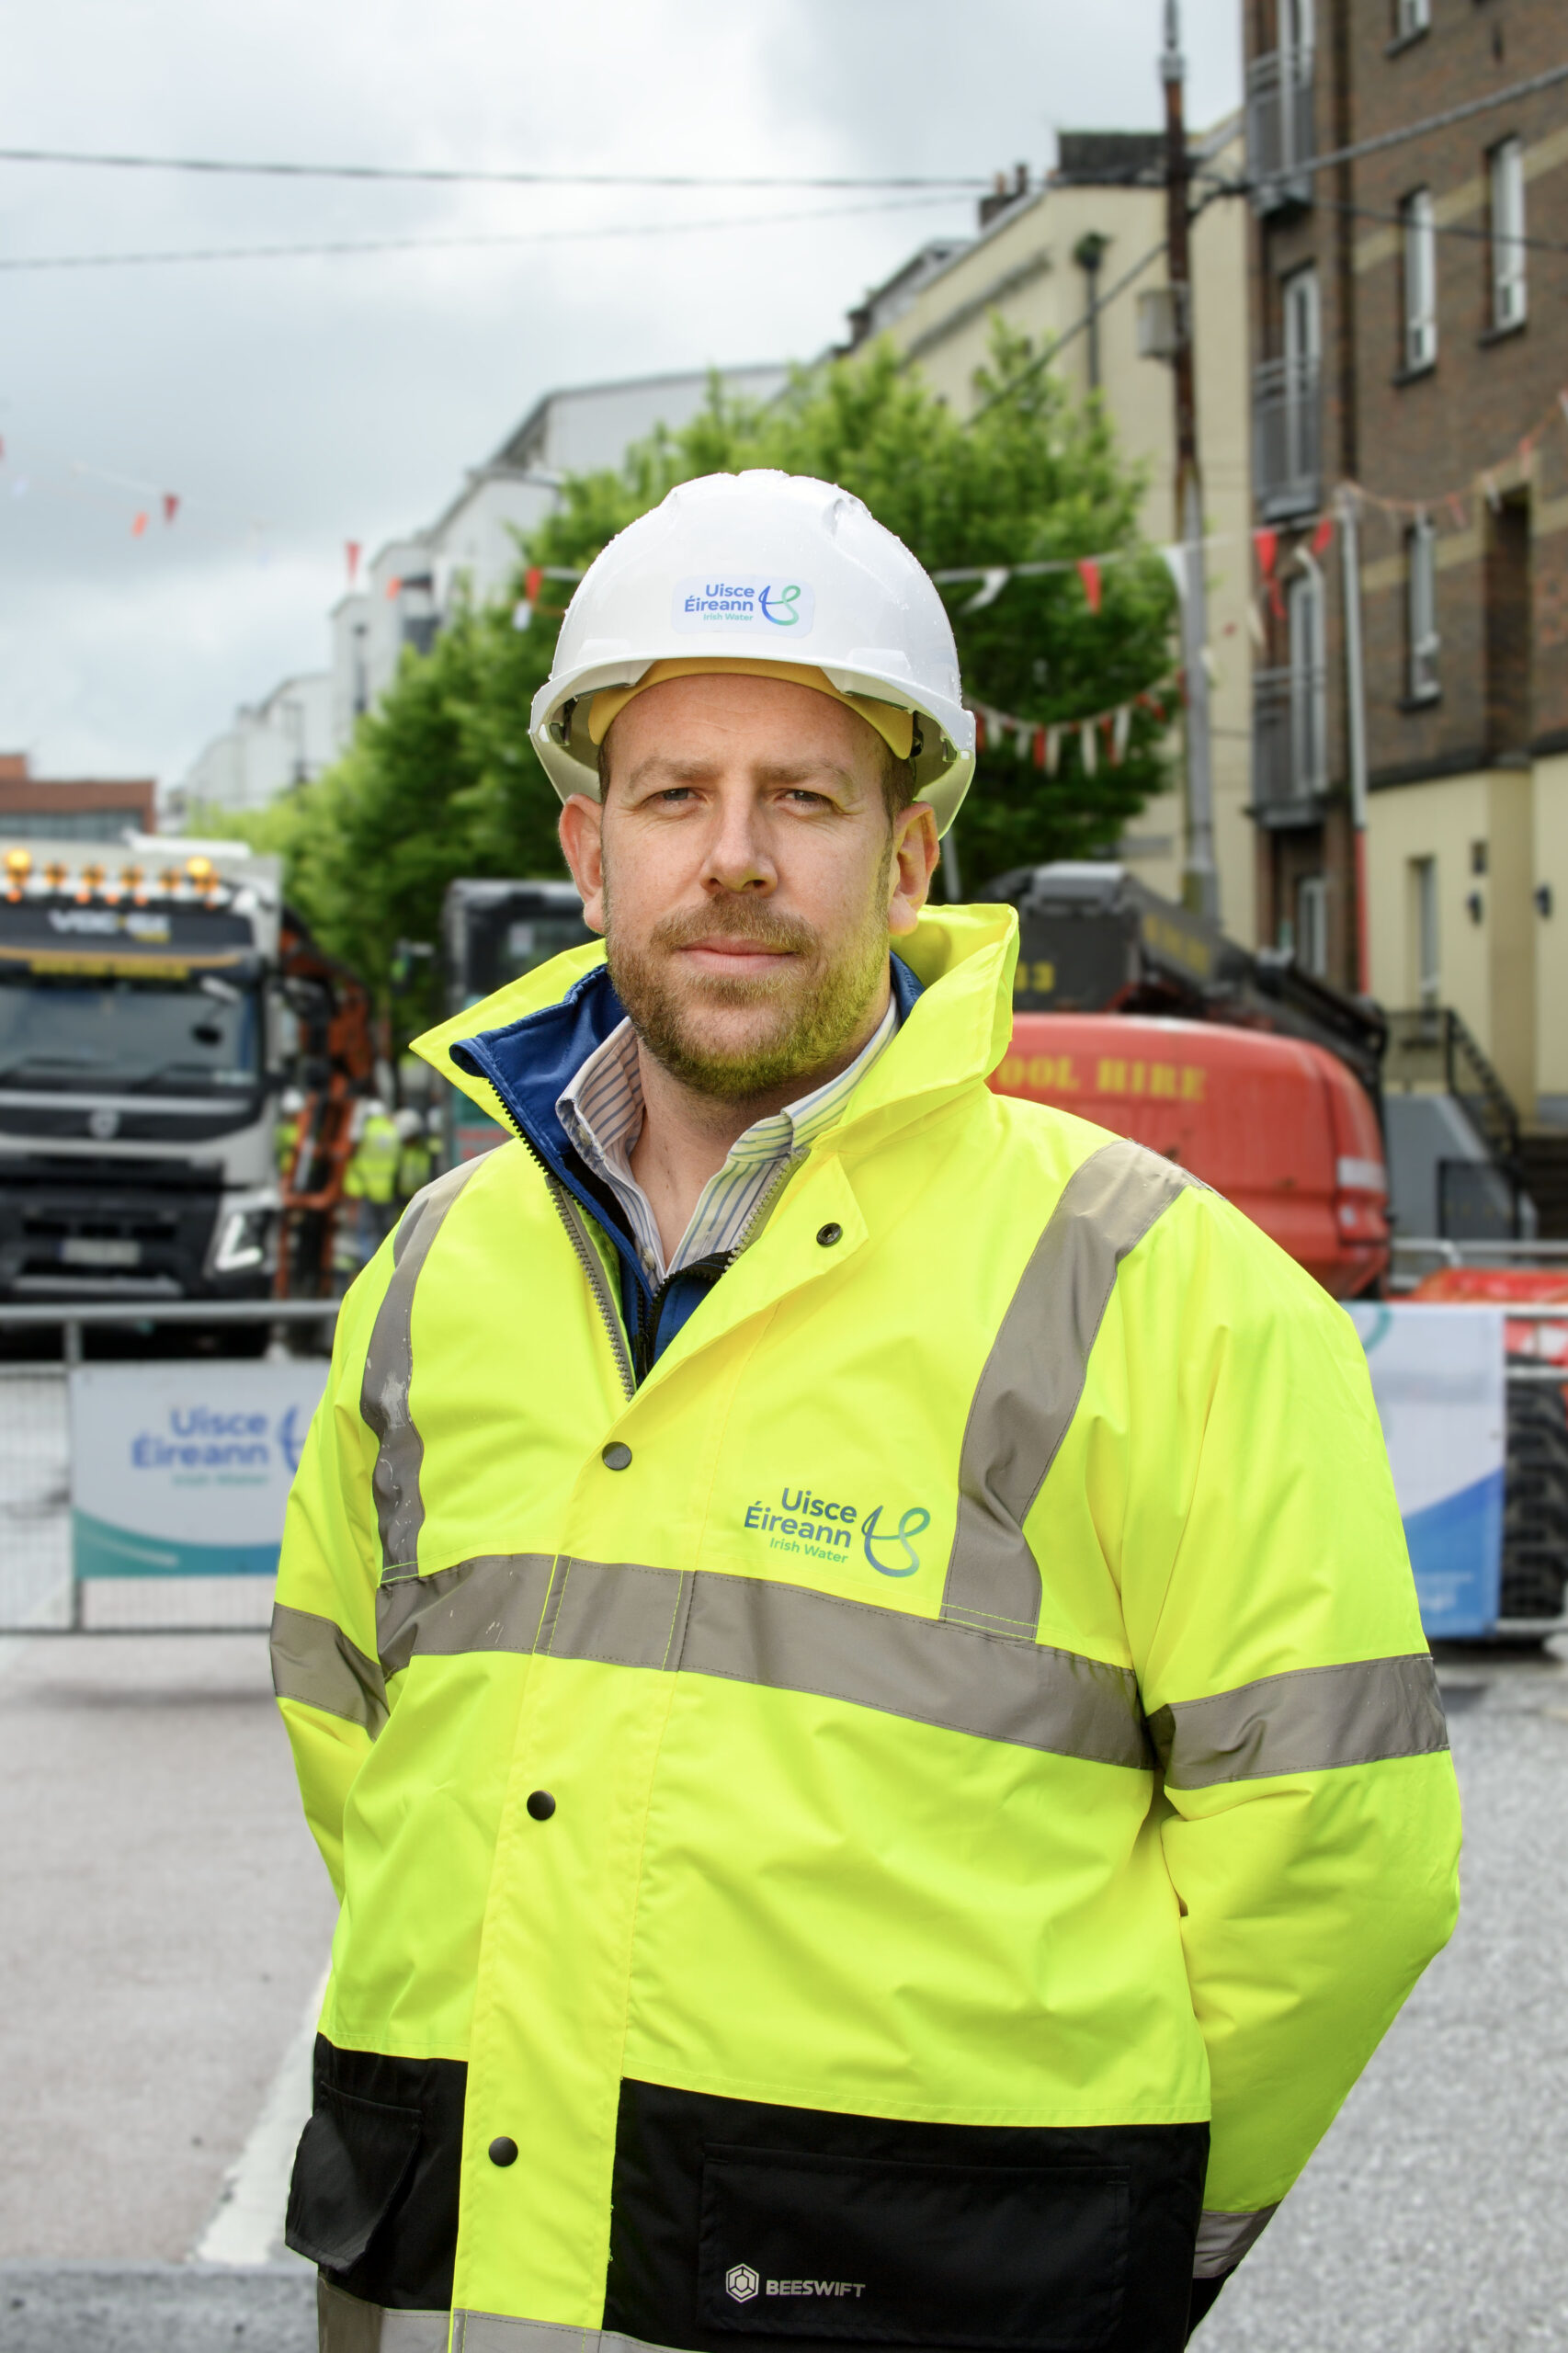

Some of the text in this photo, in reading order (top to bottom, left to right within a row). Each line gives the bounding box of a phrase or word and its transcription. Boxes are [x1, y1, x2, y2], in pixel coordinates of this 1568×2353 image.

[685, 595, 754, 613] Éireann
[705, 584, 756, 597] Uisce
[703, 613, 754, 621] Irish Water
[1096, 1058, 1205, 1100] HIRE
[169, 1405, 267, 1438] Uisce
[131, 1429, 269, 1469] Éireann
[781, 1487, 858, 1523] Uisce
[744, 1501, 852, 1548] Éireann
[768, 1537, 849, 1564] Irish Water
[766, 2279, 867, 2298] BEESWIFT
